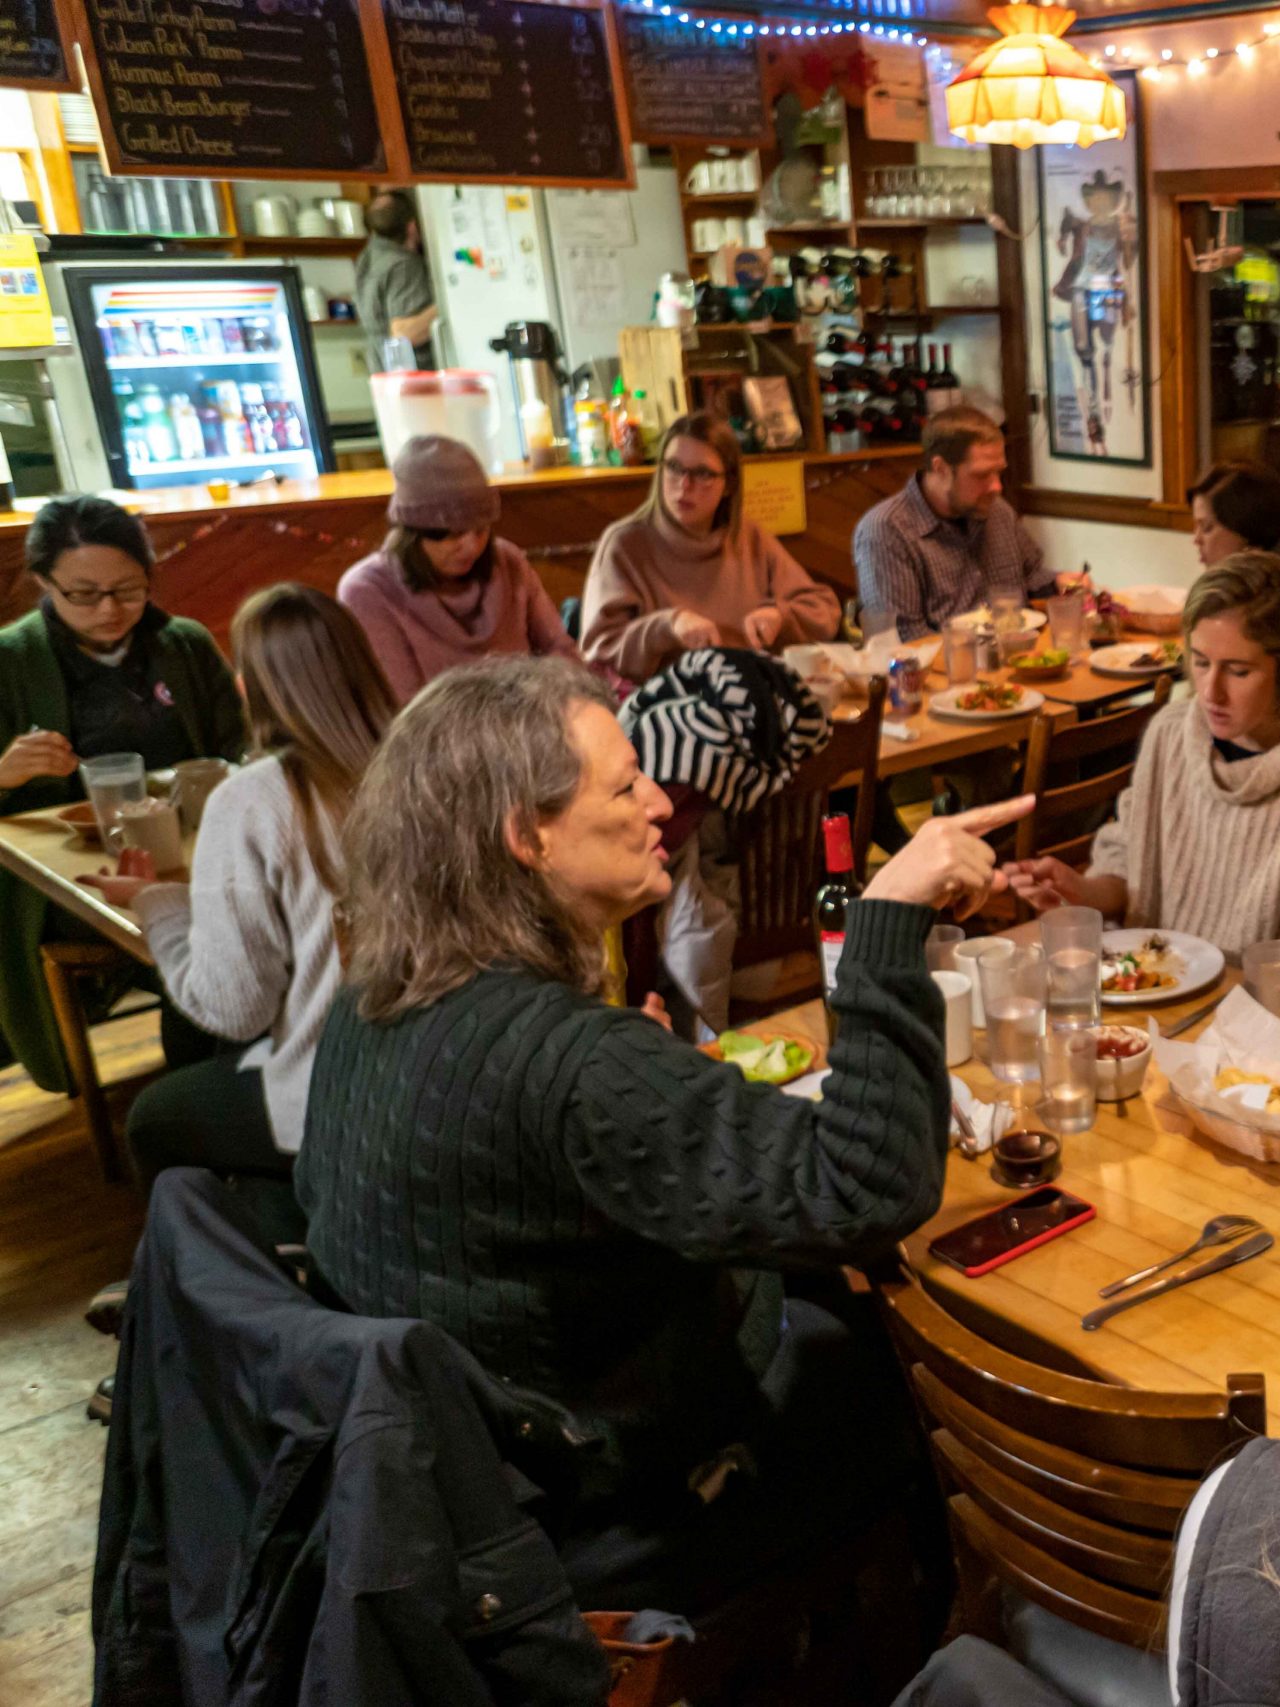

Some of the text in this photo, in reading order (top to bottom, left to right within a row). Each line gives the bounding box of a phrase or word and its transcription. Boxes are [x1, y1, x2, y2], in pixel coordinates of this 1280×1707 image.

[112, 87, 162, 115] Black
[161, 88, 200, 117] Bean
[198, 90, 252, 126] Burger
